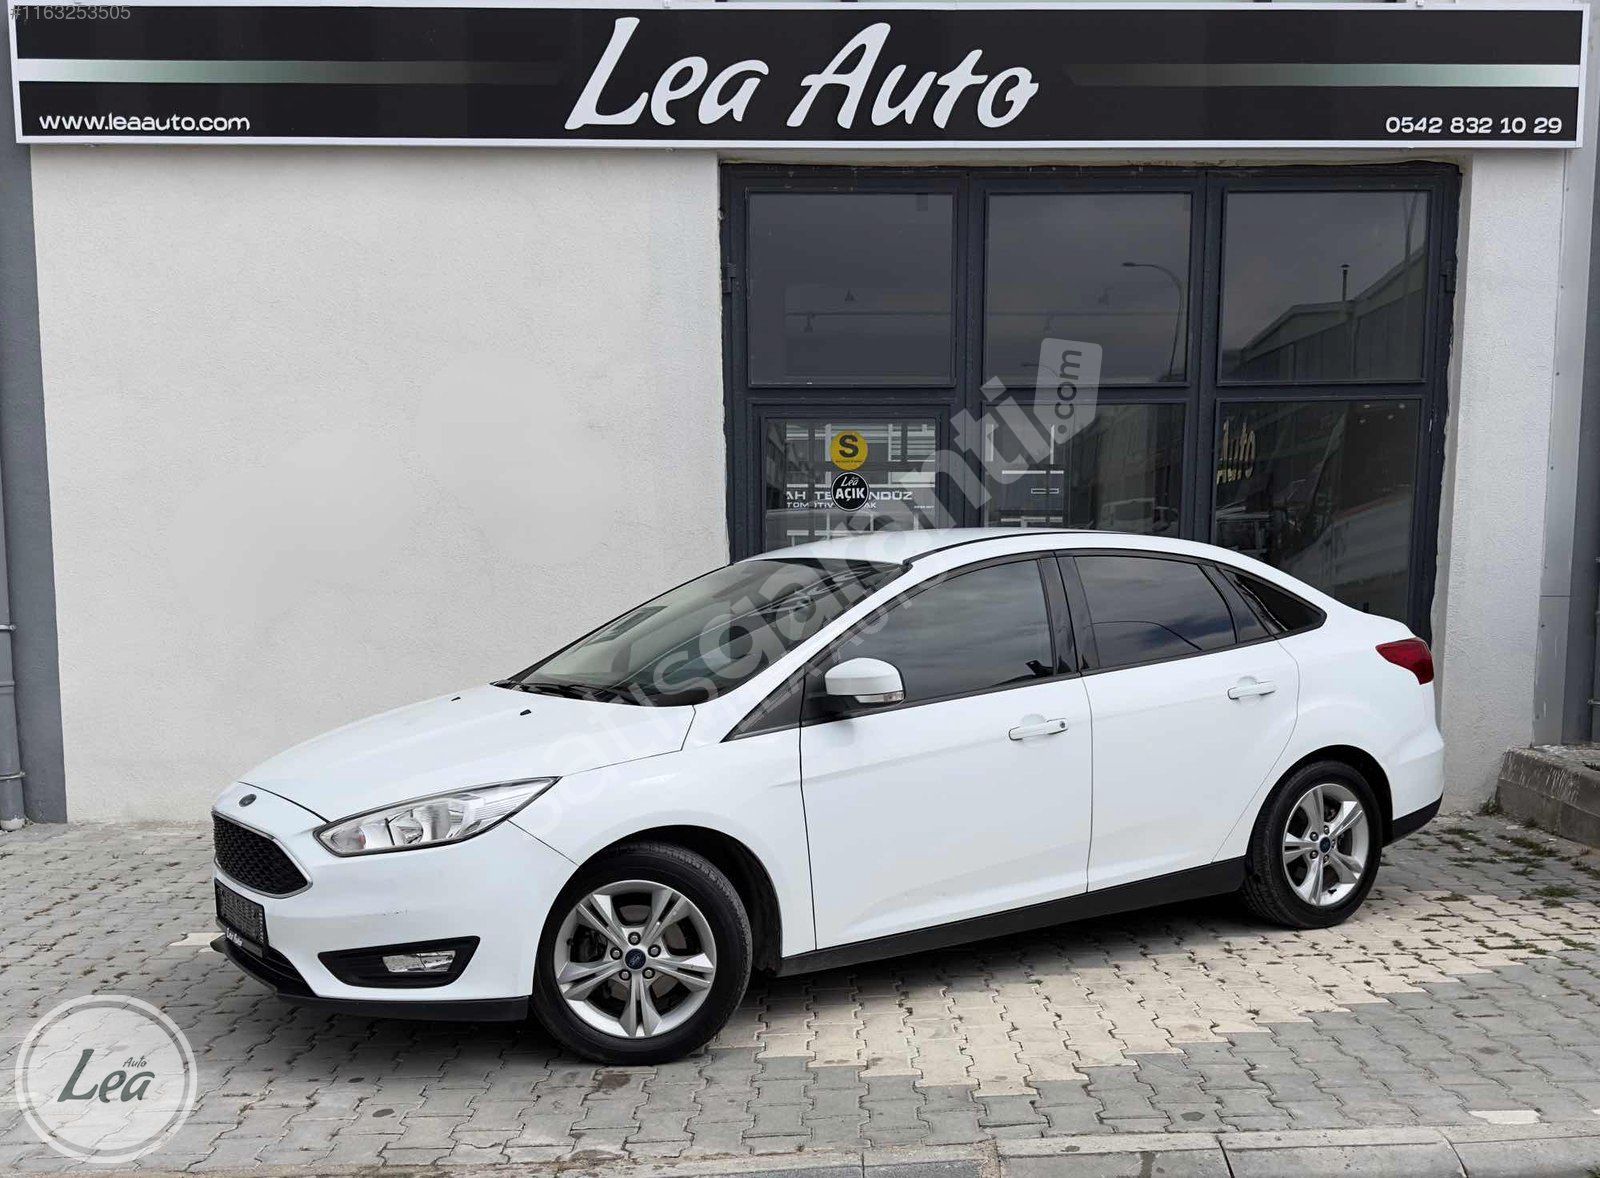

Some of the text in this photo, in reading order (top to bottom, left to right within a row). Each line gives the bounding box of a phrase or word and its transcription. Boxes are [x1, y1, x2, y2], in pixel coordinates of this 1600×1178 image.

[565, 16, 1040, 130] Lea Auto
[39, 112, 251, 131] www.leaauto.com
[1385, 116, 1563, 134] 0542 832 10 29
[839, 434, 859, 458] S
[835, 487, 866, 502] AÇIK
